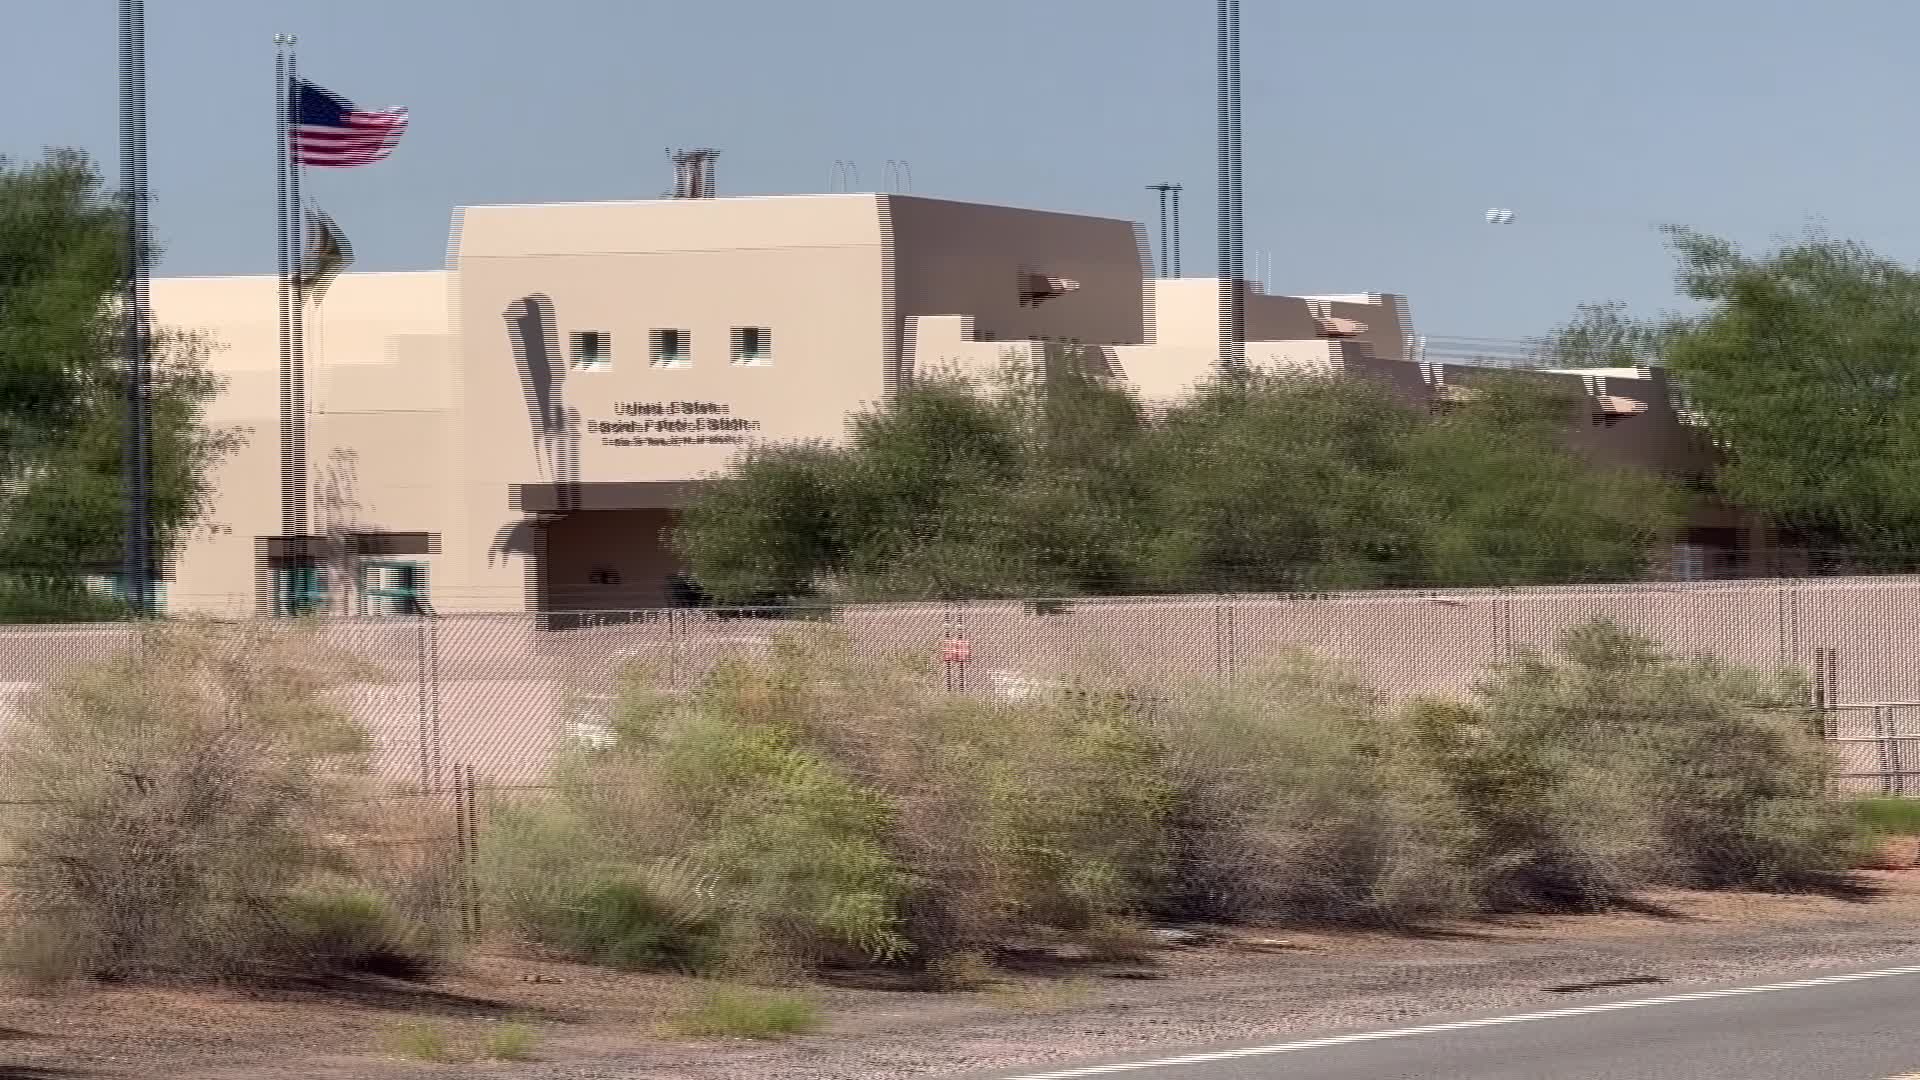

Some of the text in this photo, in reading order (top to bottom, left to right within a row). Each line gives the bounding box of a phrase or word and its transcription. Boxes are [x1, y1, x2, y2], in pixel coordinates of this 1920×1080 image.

[615, 401, 729, 416] United States
[588, 418, 648, 433] Border
[697, 417, 760, 431] Station
